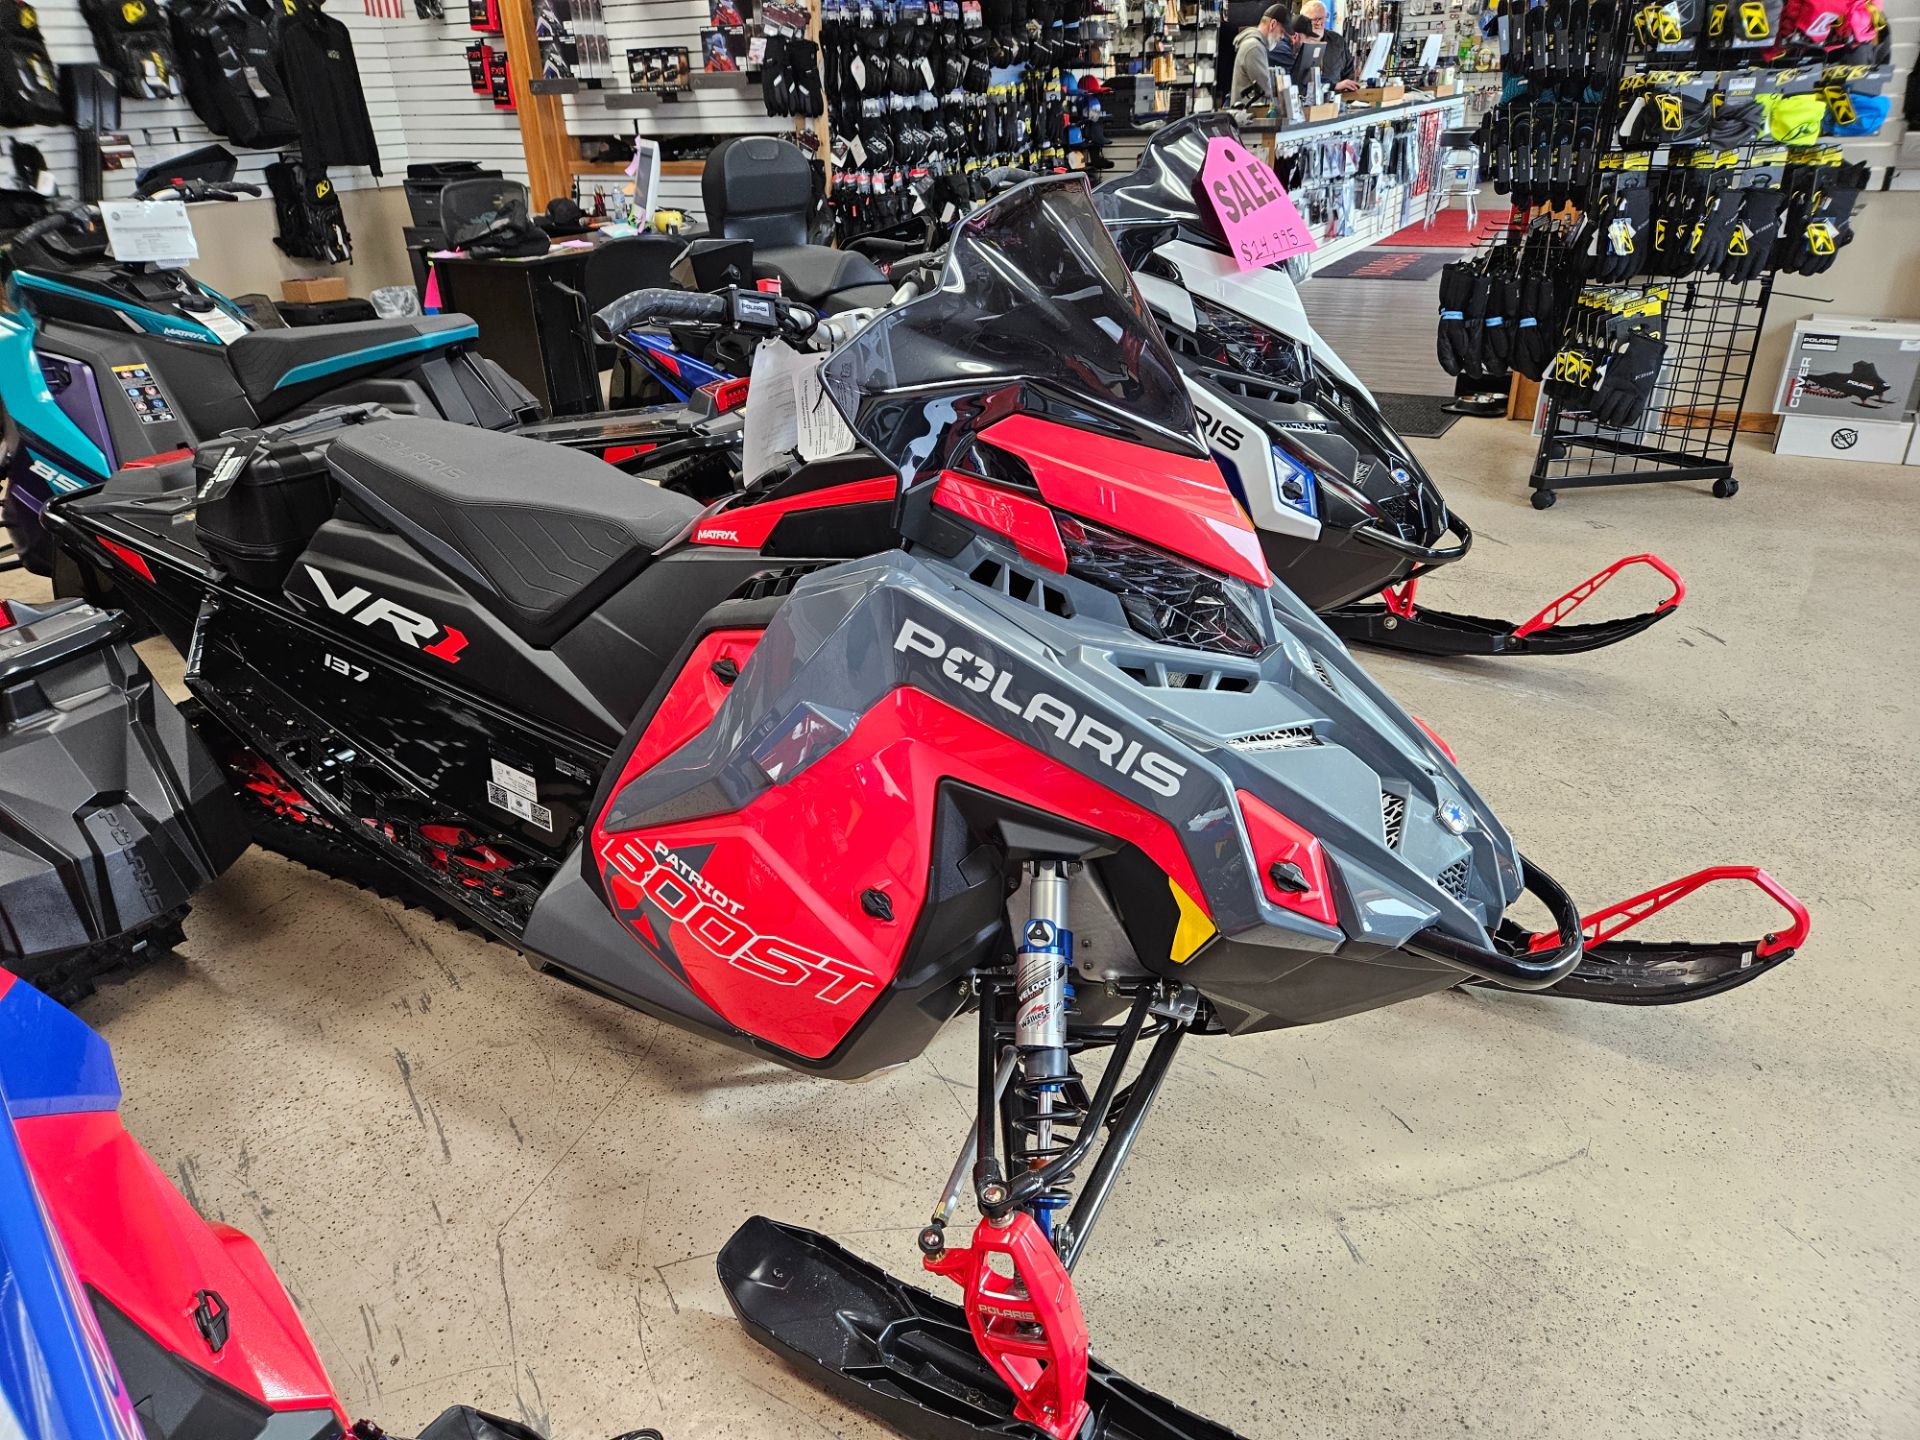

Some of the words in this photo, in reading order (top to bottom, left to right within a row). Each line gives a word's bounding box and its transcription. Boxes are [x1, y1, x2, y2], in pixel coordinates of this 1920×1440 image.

[1213, 161, 1281, 224] SALE!
[1240, 228, 1299, 264] $14,995
[741, 302, 767, 312] POLARIS
[164, 327, 208, 342] MATRYX
[1790, 357, 1812, 408] COVER
[698, 529, 739, 543] MATRYX
[304, 564, 470, 664] VR1
[324, 653, 370, 683] 137
[894, 618, 1188, 797] POLARIS
[654, 841, 745, 915] PATRIOT
[600, 837, 875, 1005] BOOST
[978, 1304, 1035, 1320] POLARIS
